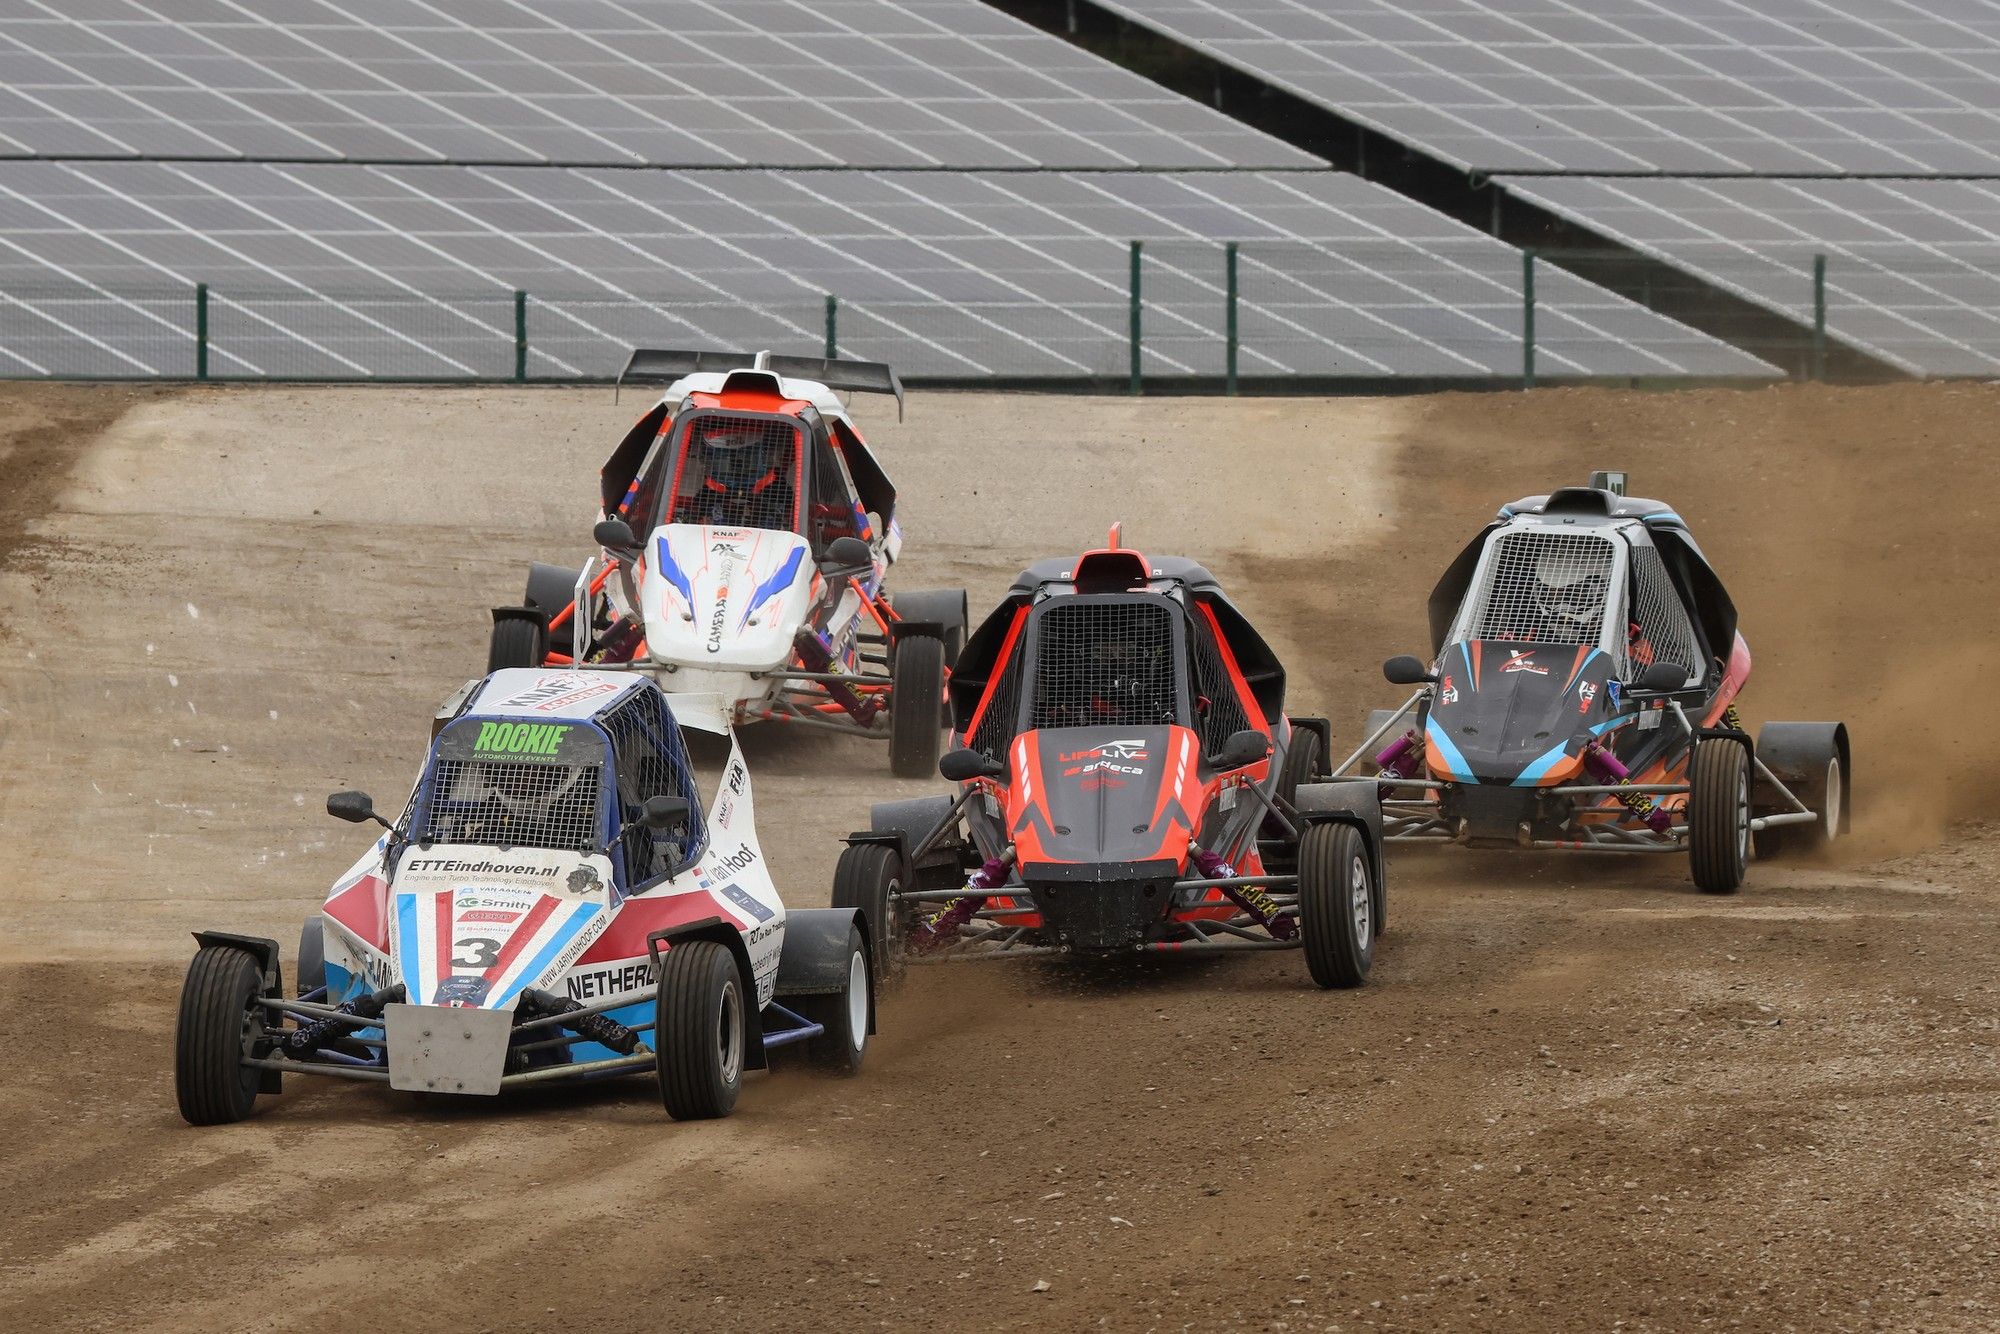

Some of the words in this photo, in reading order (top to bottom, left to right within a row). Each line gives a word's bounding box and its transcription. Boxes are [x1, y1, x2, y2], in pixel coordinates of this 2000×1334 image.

[474, 722, 569, 755] ROOKIE
[472, 753, 524, 761] AUTOMOTIVE
[525, 755, 557, 763] EVENTS
[407, 860, 560, 877] ETTEindhoven.nl
[724, 842, 757, 874] Hoof
[404, 874, 430, 882] Engine
[449, 874, 469, 882] Turbo
[471, 875, 512, 885] Technology
[515, 877, 555, 887] Eindhoven
[481, 899, 531, 910] Smith
[450, 938, 502, 968] 3
[539, 914, 608, 989] WWW.JARIVANHOOF.COM
[566, 964, 660, 1001] NETHERL
